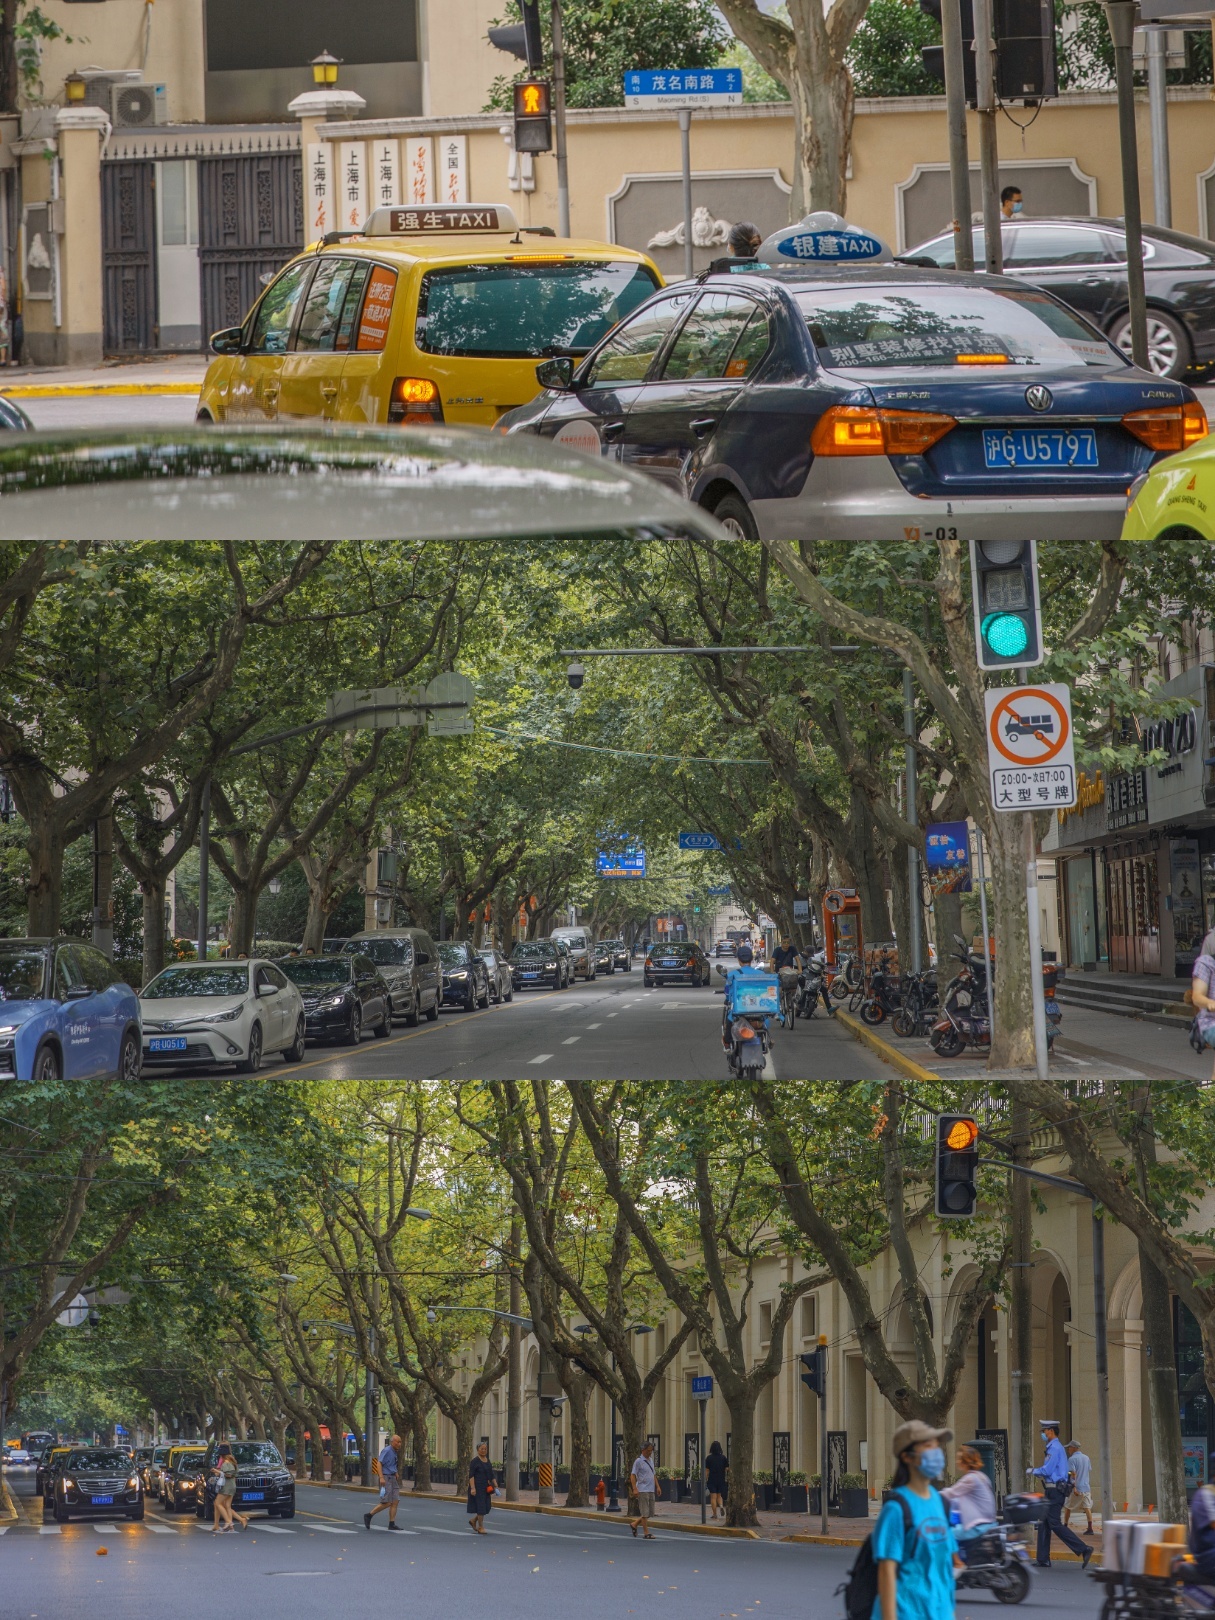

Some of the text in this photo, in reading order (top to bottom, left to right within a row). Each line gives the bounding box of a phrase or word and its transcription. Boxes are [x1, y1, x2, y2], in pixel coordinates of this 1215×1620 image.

[631, 75, 640, 85] 南
[652, 75, 714, 91] 茂名南路
[726, 73, 736, 83] 北
[657, 96, 686, 104] Maoming
[728, 95, 735, 103] N
[447, 143, 459, 169] 全国
[314, 151, 326, 197] 上海市
[347, 150, 359, 201] 上海市
[380, 147, 392, 206] 上海市
[830, 335, 999, 362] 别墅装修找申远
[837, 351, 921, 368] 400-166-2666
[1001, 770, 1066, 785] 20:00-次日7:00
[1000, 785, 1069, 804] 大型号牌
[946, 849, 965, 860] 友善
